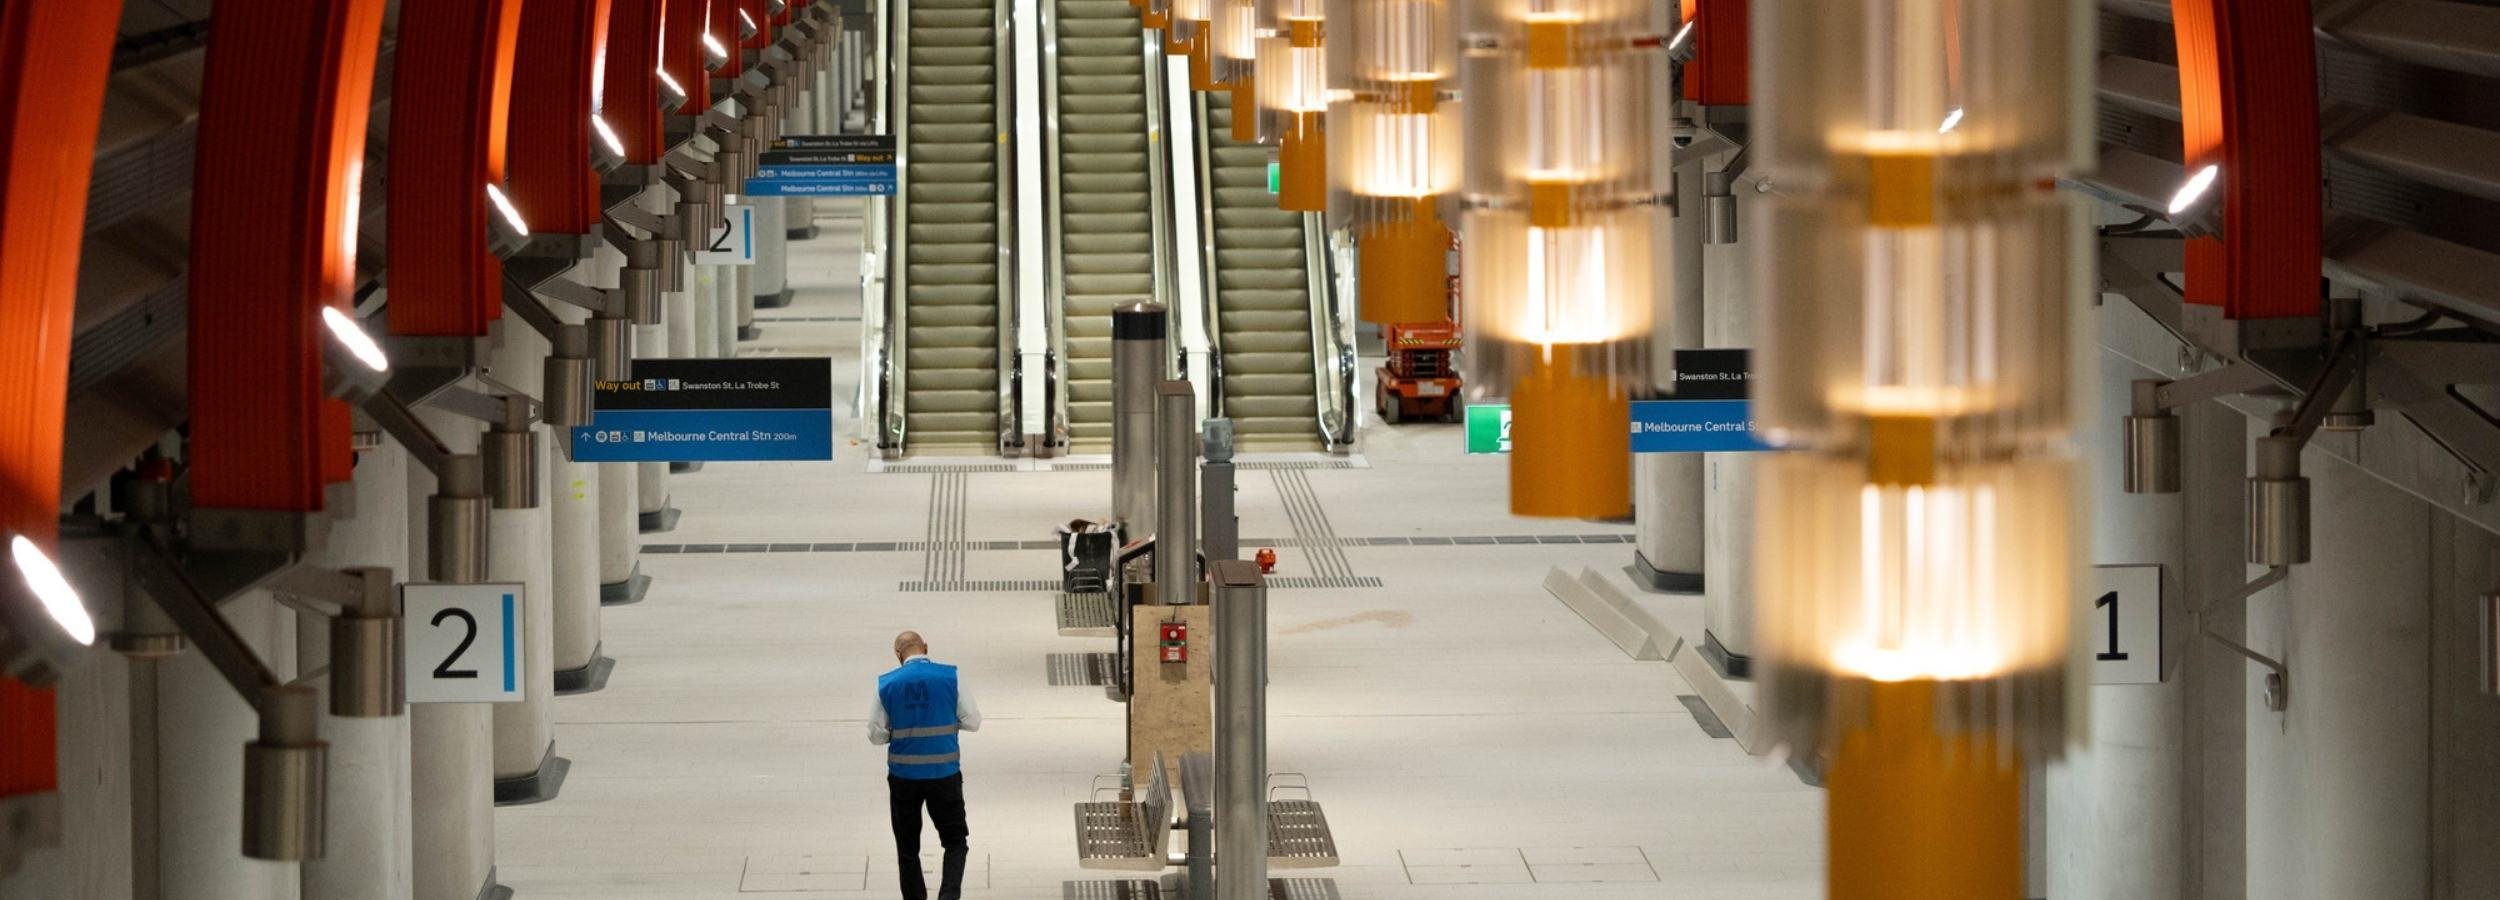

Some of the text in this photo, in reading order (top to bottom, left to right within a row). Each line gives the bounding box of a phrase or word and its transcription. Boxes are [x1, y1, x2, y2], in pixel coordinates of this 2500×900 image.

[816, 169, 841, 177] Central
[781, 185, 815, 193] Melbourne
[816, 184, 841, 192] Central
[710, 217, 732, 252] 2
[1680, 372, 1718, 381] Swanston
[1731, 372, 1742, 380] La
[595, 380, 780, 393] Way out Swanston St, La Trobe St
[1644, 422, 1702, 433] Melbourne
[1704, 421, 1746, 432] Central
[648, 430, 797, 442] Melbourne Central Stn 200m
[2095, 590, 2128, 661] 1
[430, 607, 478, 679] 2
